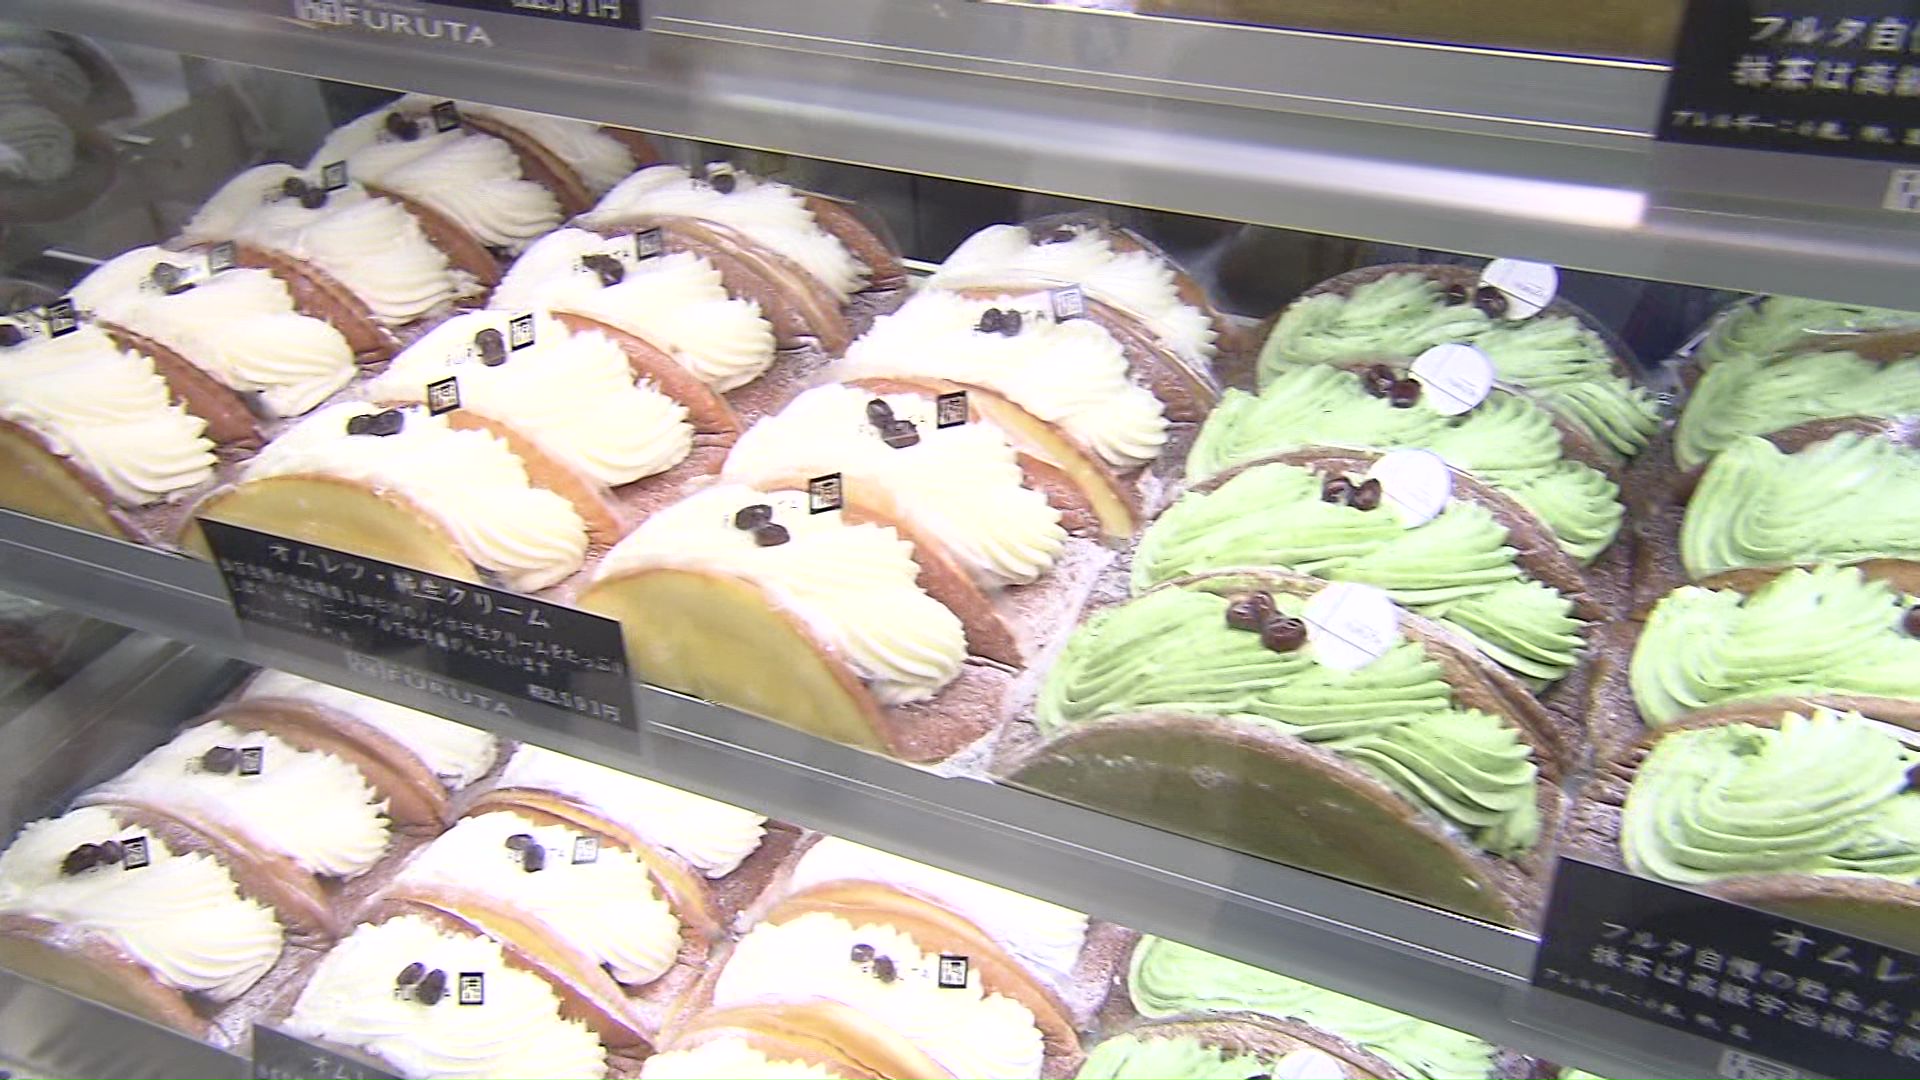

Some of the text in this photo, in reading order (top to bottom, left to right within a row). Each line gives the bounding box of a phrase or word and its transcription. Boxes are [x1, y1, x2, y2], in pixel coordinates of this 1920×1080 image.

[344, 5, 495, 47] FURUTA
[1749, 15, 1920, 53] フルタ自
[388, 666, 514, 716] FURUTA
